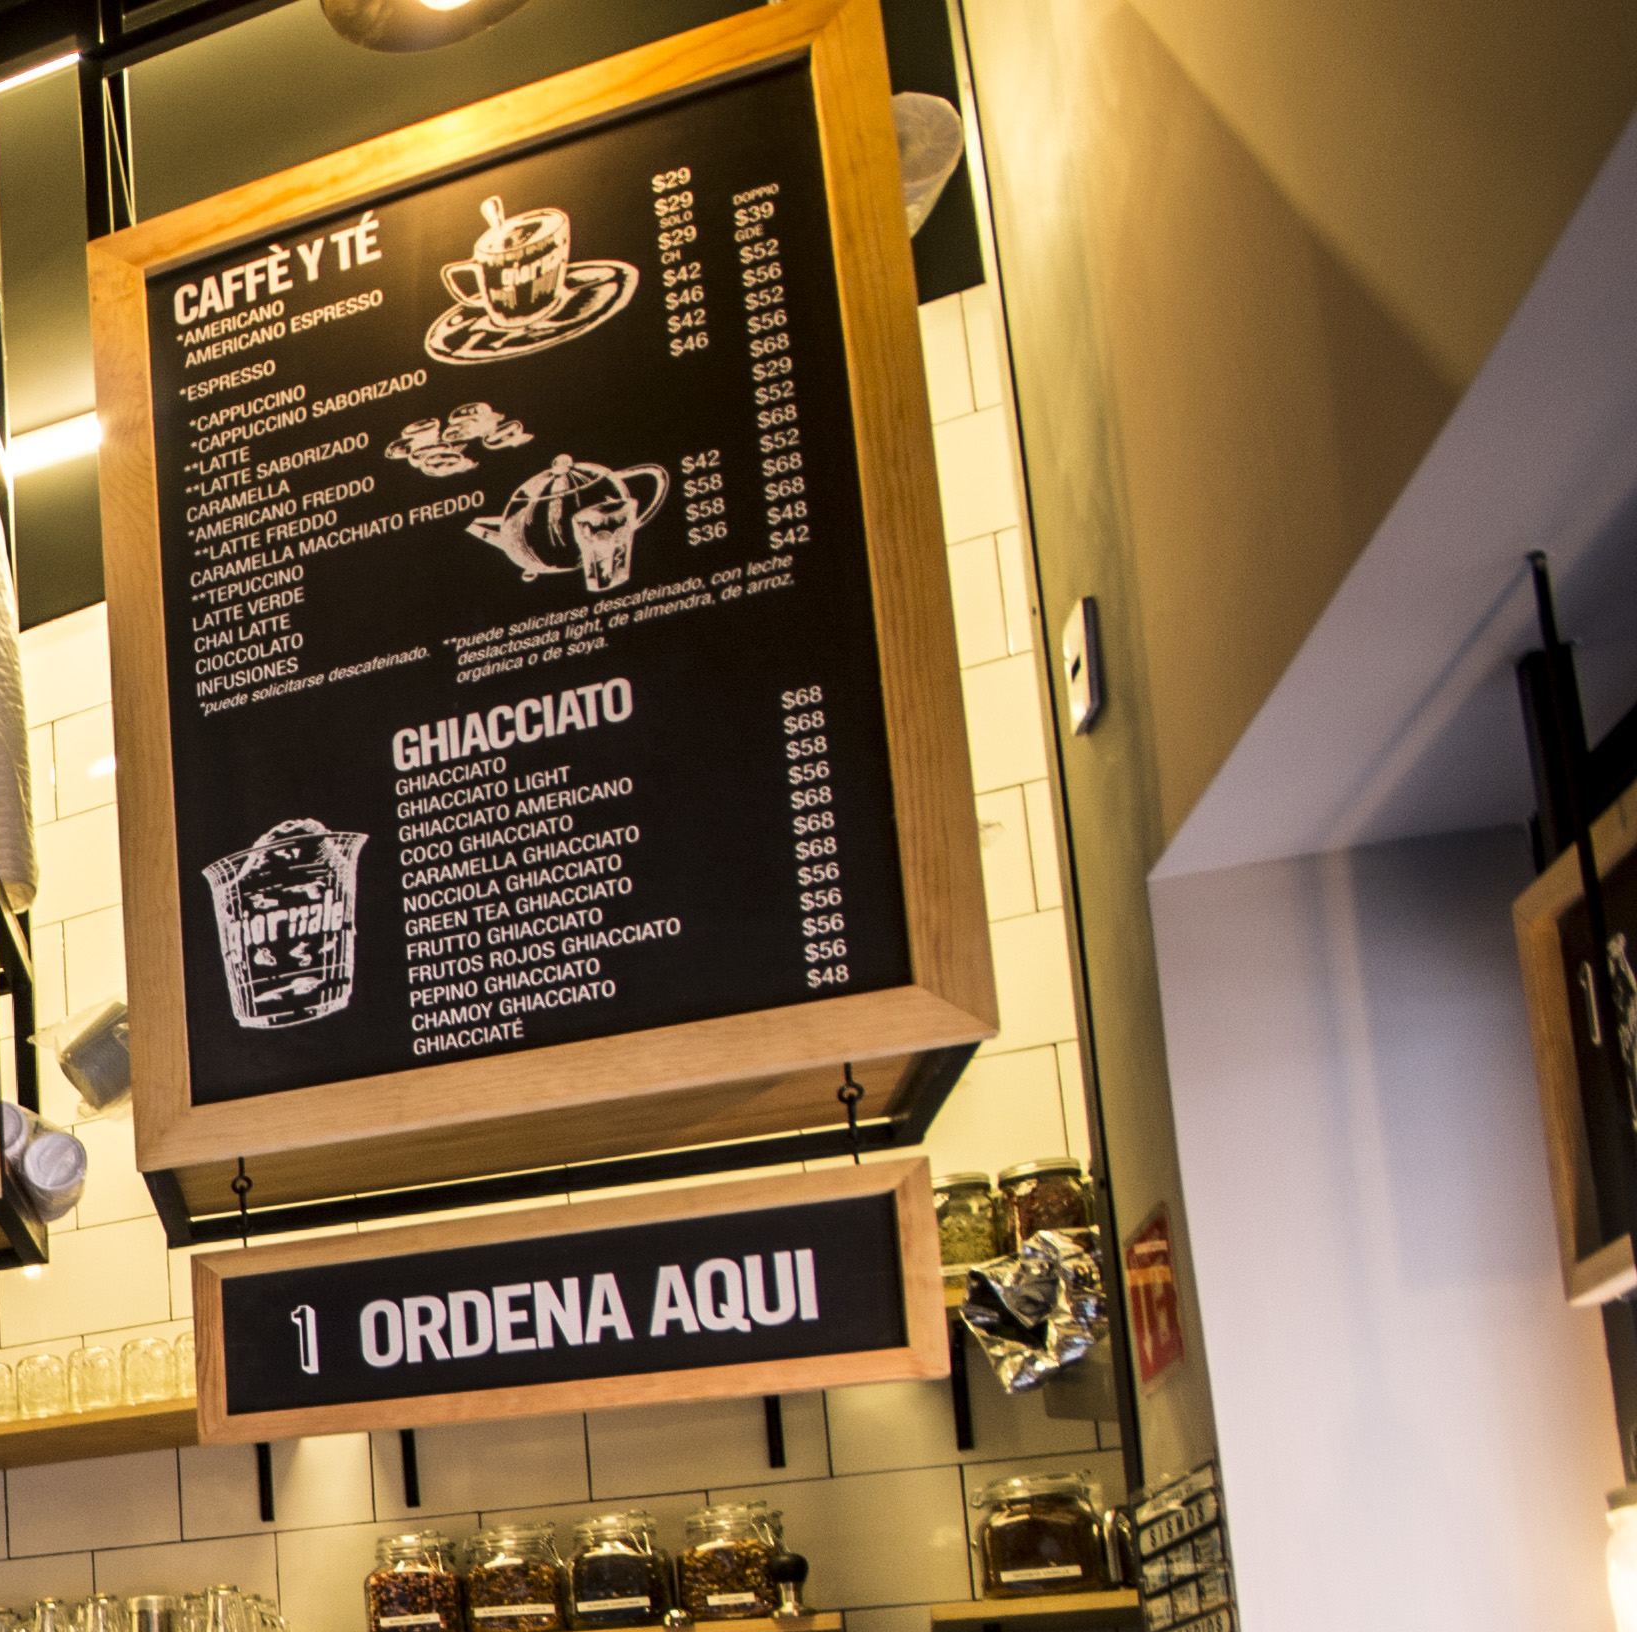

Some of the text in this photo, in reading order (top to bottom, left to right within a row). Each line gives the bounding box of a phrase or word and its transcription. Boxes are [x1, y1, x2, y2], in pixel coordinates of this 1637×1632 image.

[733, 183, 779, 205] DOPPIO
[734, 201, 774, 227] $39
[659, 210, 693, 229] SOLO
[734, 223, 762, 242] GDE
[174, 209, 382, 325] CAFFÈ Y TÉ
[661, 249, 681, 264] CH
[185, 289, 383, 368] AMERICANO ESPRESSO
[190, 490, 484, 587] CARAMELLA MACCHIATO FREDDO
[688, 521, 727, 545] $36
[194, 612, 290, 652] CHAI LATTE
[195, 632, 303, 674] CIOCCOLATO
[456, 636, 608, 683] orgánica o de soya.
[197, 656, 298, 696] INFUSIONES
[392, 677, 633, 771] GHIACCIATO
[408, 917, 681, 984] FRUTOS ROJOS GHIACCIATO
[413, 1017, 524, 1055] GHIACCIATÉ
[290, 1248, 819, 1374] 1 ORDENA AQUI
